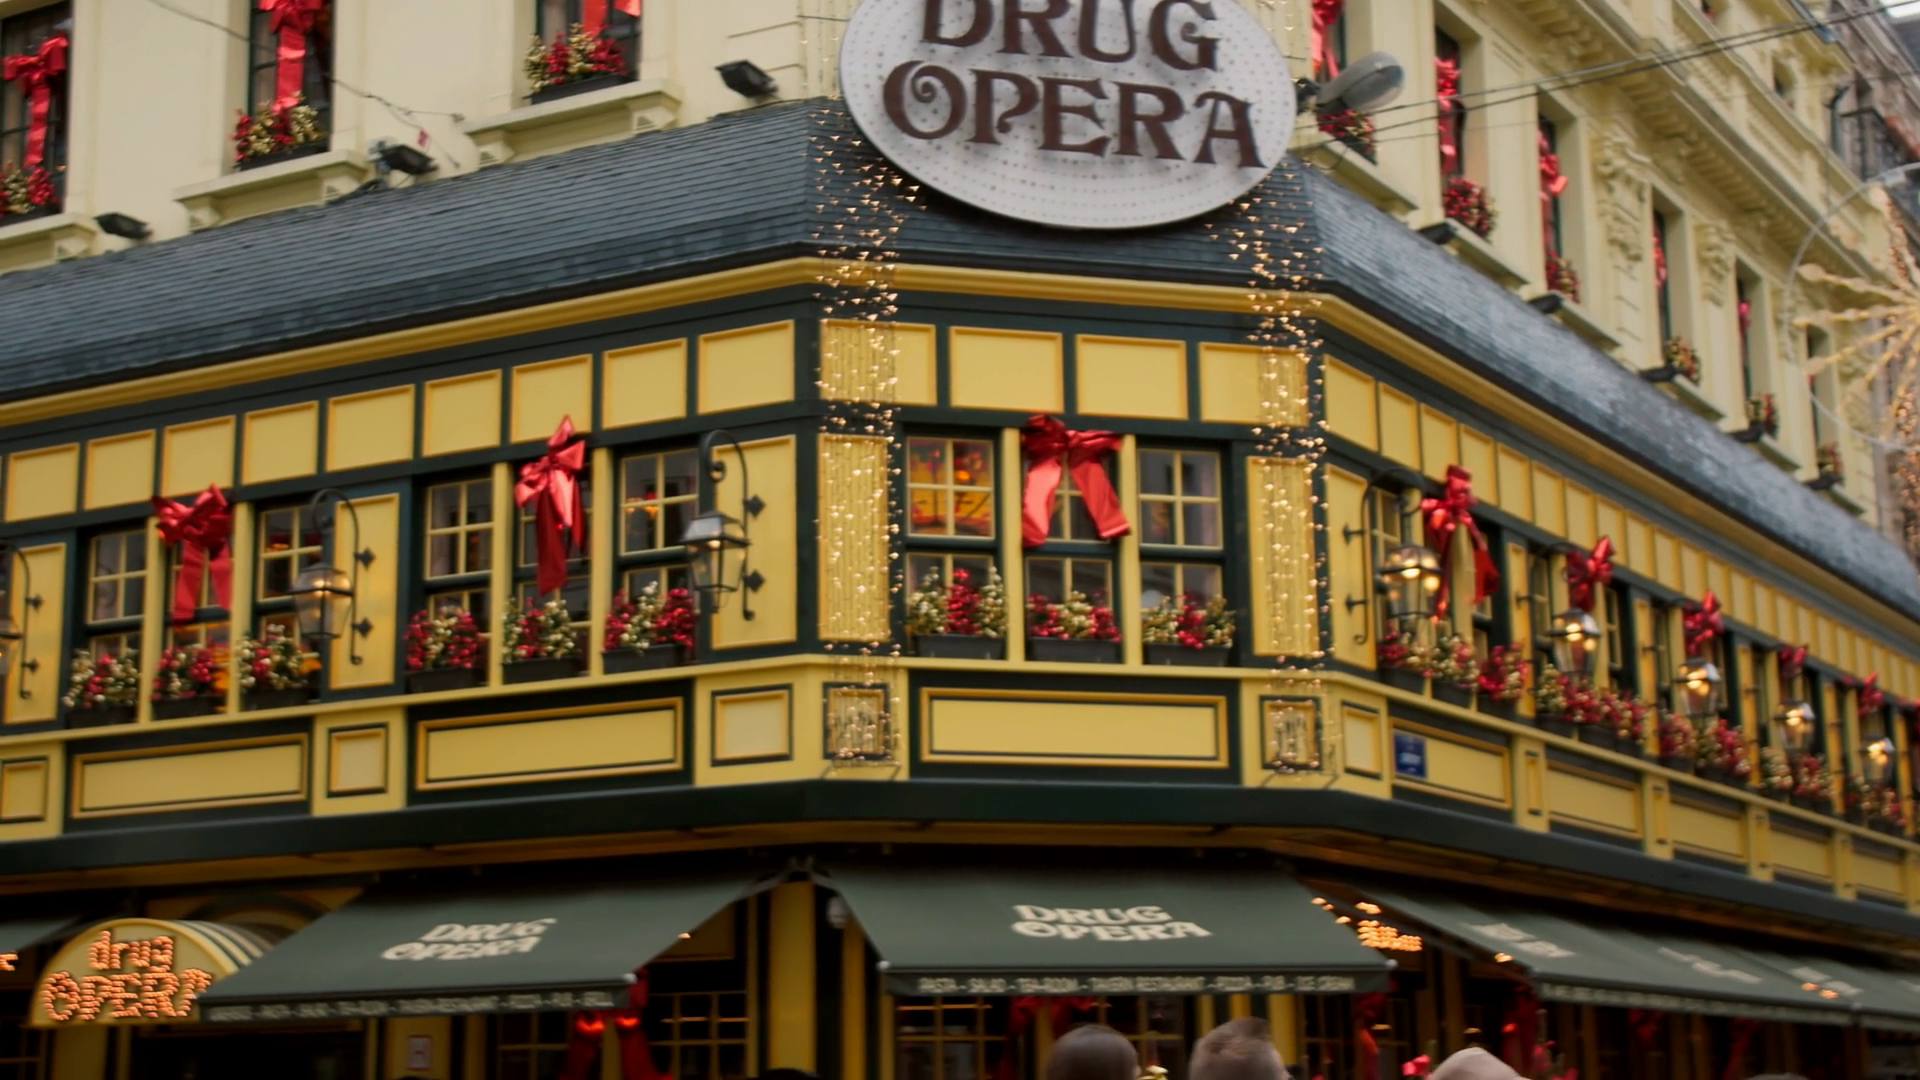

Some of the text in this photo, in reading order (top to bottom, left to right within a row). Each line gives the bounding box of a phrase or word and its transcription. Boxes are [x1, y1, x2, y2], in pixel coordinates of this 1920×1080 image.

[920, 0, 1221, 72] DRUG
[882, 60, 1267, 169] OPERA
[1012, 904, 1173, 925] DRUG
[418, 917, 557, 943] DRUG
[1010, 920, 1214, 942] OPERA
[380, 936, 542, 961] OPERA
